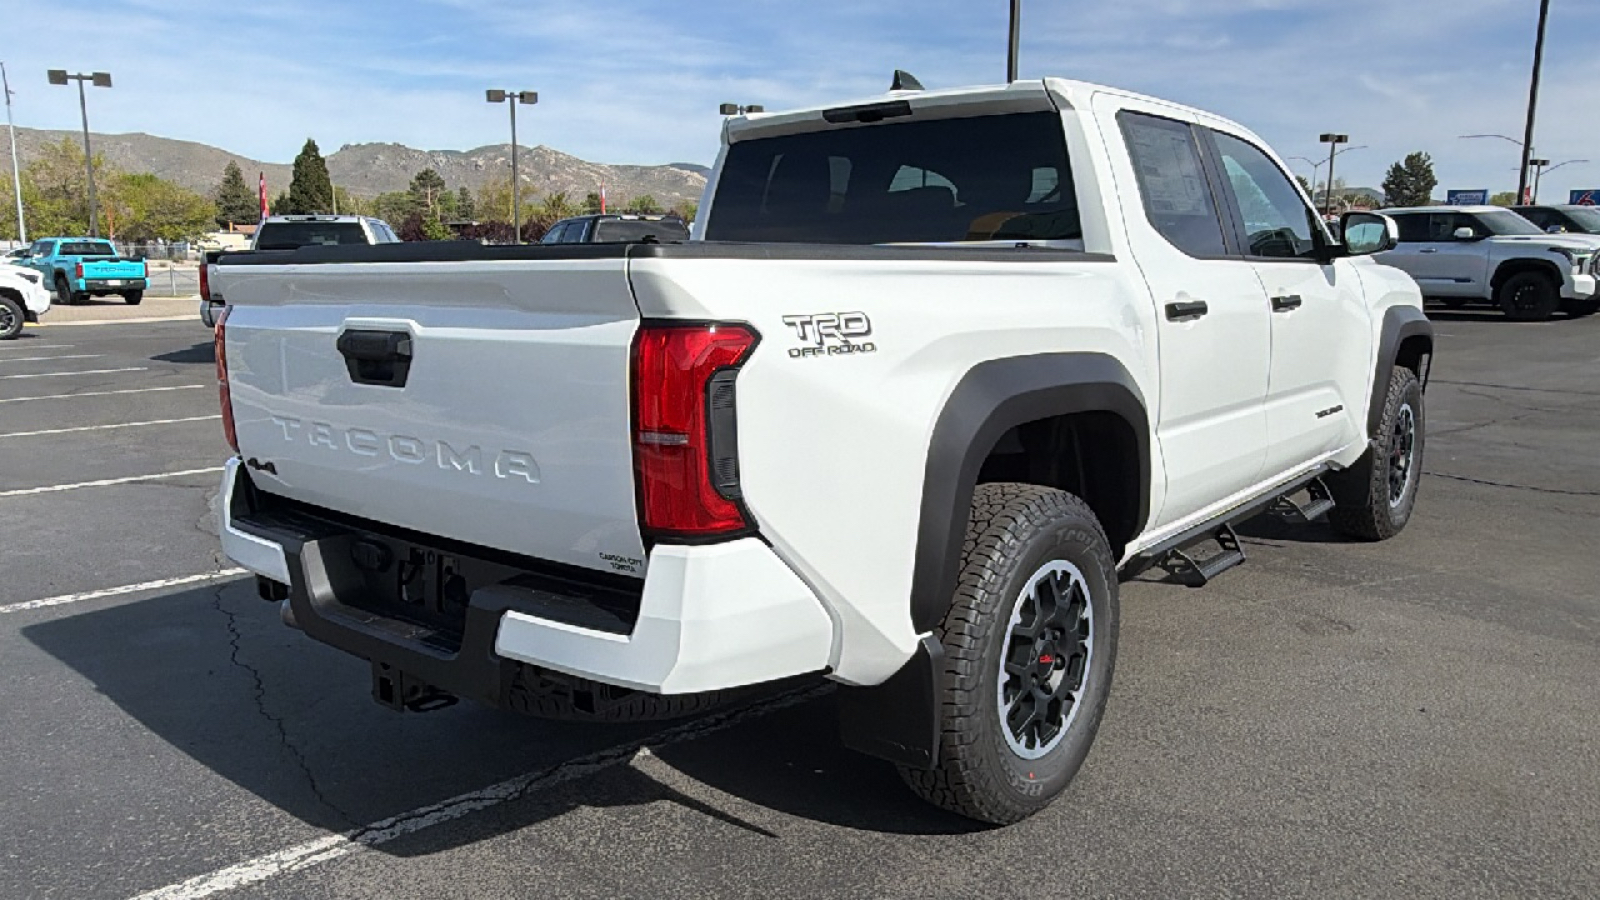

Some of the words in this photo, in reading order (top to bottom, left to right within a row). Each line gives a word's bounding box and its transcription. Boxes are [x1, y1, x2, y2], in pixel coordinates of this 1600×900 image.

[782, 311, 872, 345] TRD
[788, 347, 825, 358] OFF
[827, 342, 877, 356] ROAD
[272, 415, 541, 484] TACOMA
